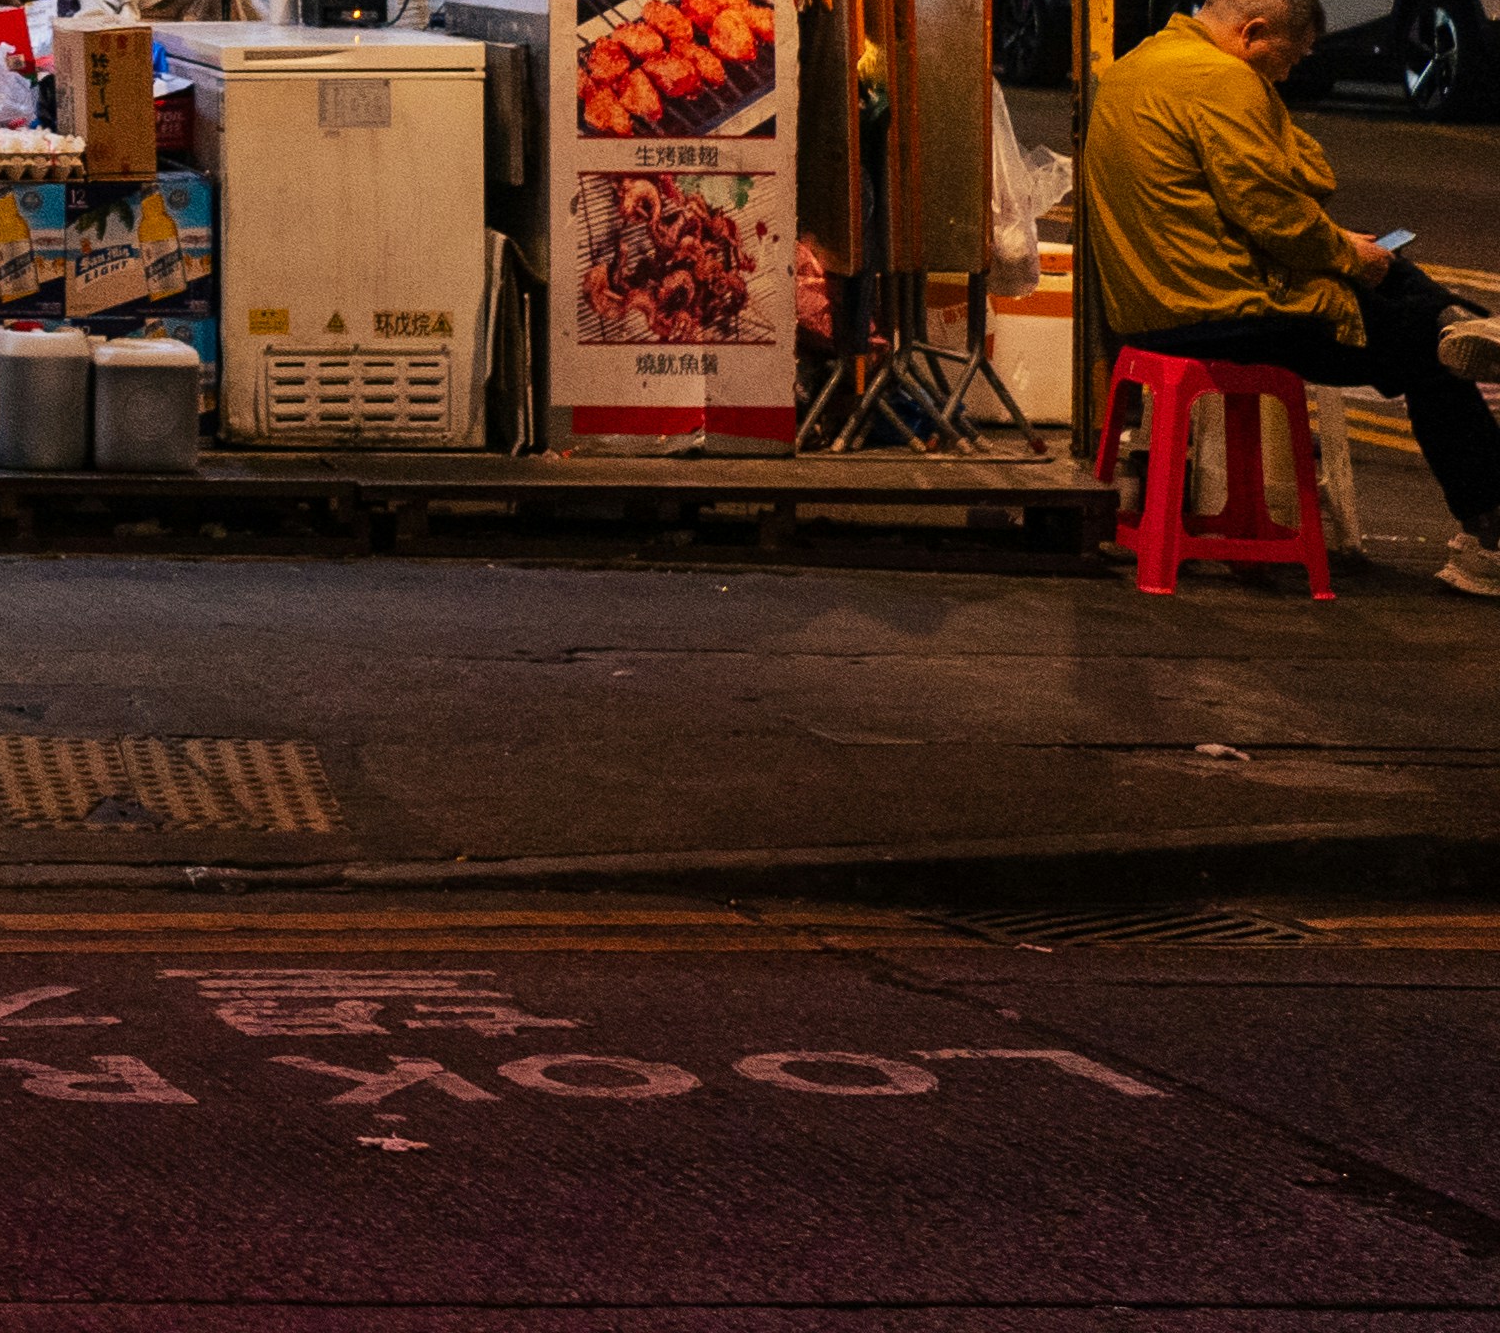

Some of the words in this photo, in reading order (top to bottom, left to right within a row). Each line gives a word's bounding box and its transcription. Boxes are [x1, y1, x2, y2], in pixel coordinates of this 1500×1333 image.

[70, 190, 88, 206] 12
[84, 259, 129, 284] LIGHT
[267, 1046, 1173, 1106] LOOK
